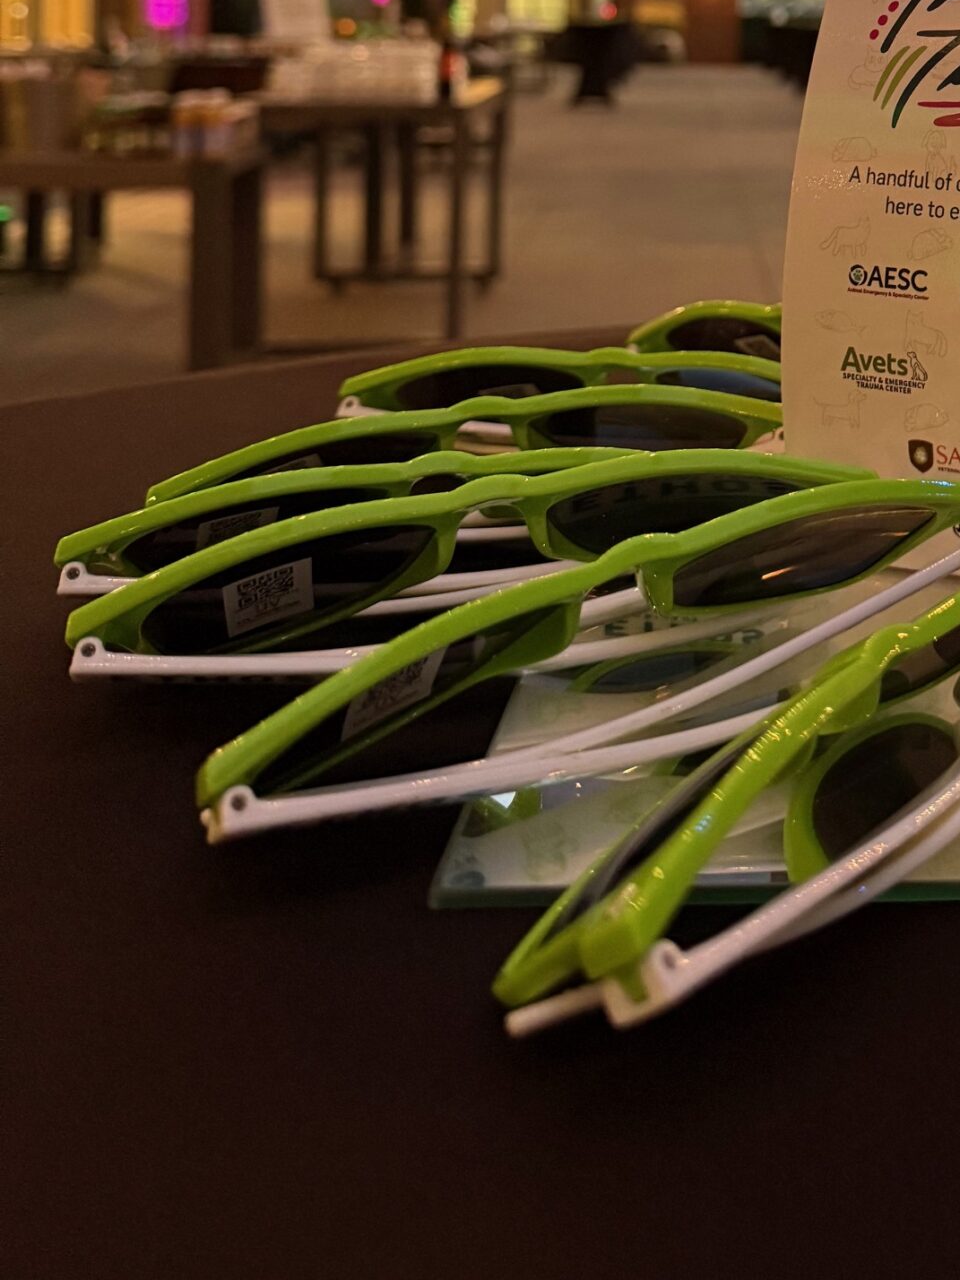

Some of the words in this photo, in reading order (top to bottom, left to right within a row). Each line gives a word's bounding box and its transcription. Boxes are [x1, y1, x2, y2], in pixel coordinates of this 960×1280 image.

[849, 166, 861, 183] A
[866, 167, 930, 189] handful
[935, 173, 953, 191] of
[885, 196, 923, 216] here
[928, 201, 945, 218] to
[841, 346, 908, 376] Avets
[843, 372, 877, 384] SPECIALTY
[884, 378, 926, 390] EMERGENCY
[856, 380, 885, 391] TRAUMA
[885, 384, 912, 395] CENTER
